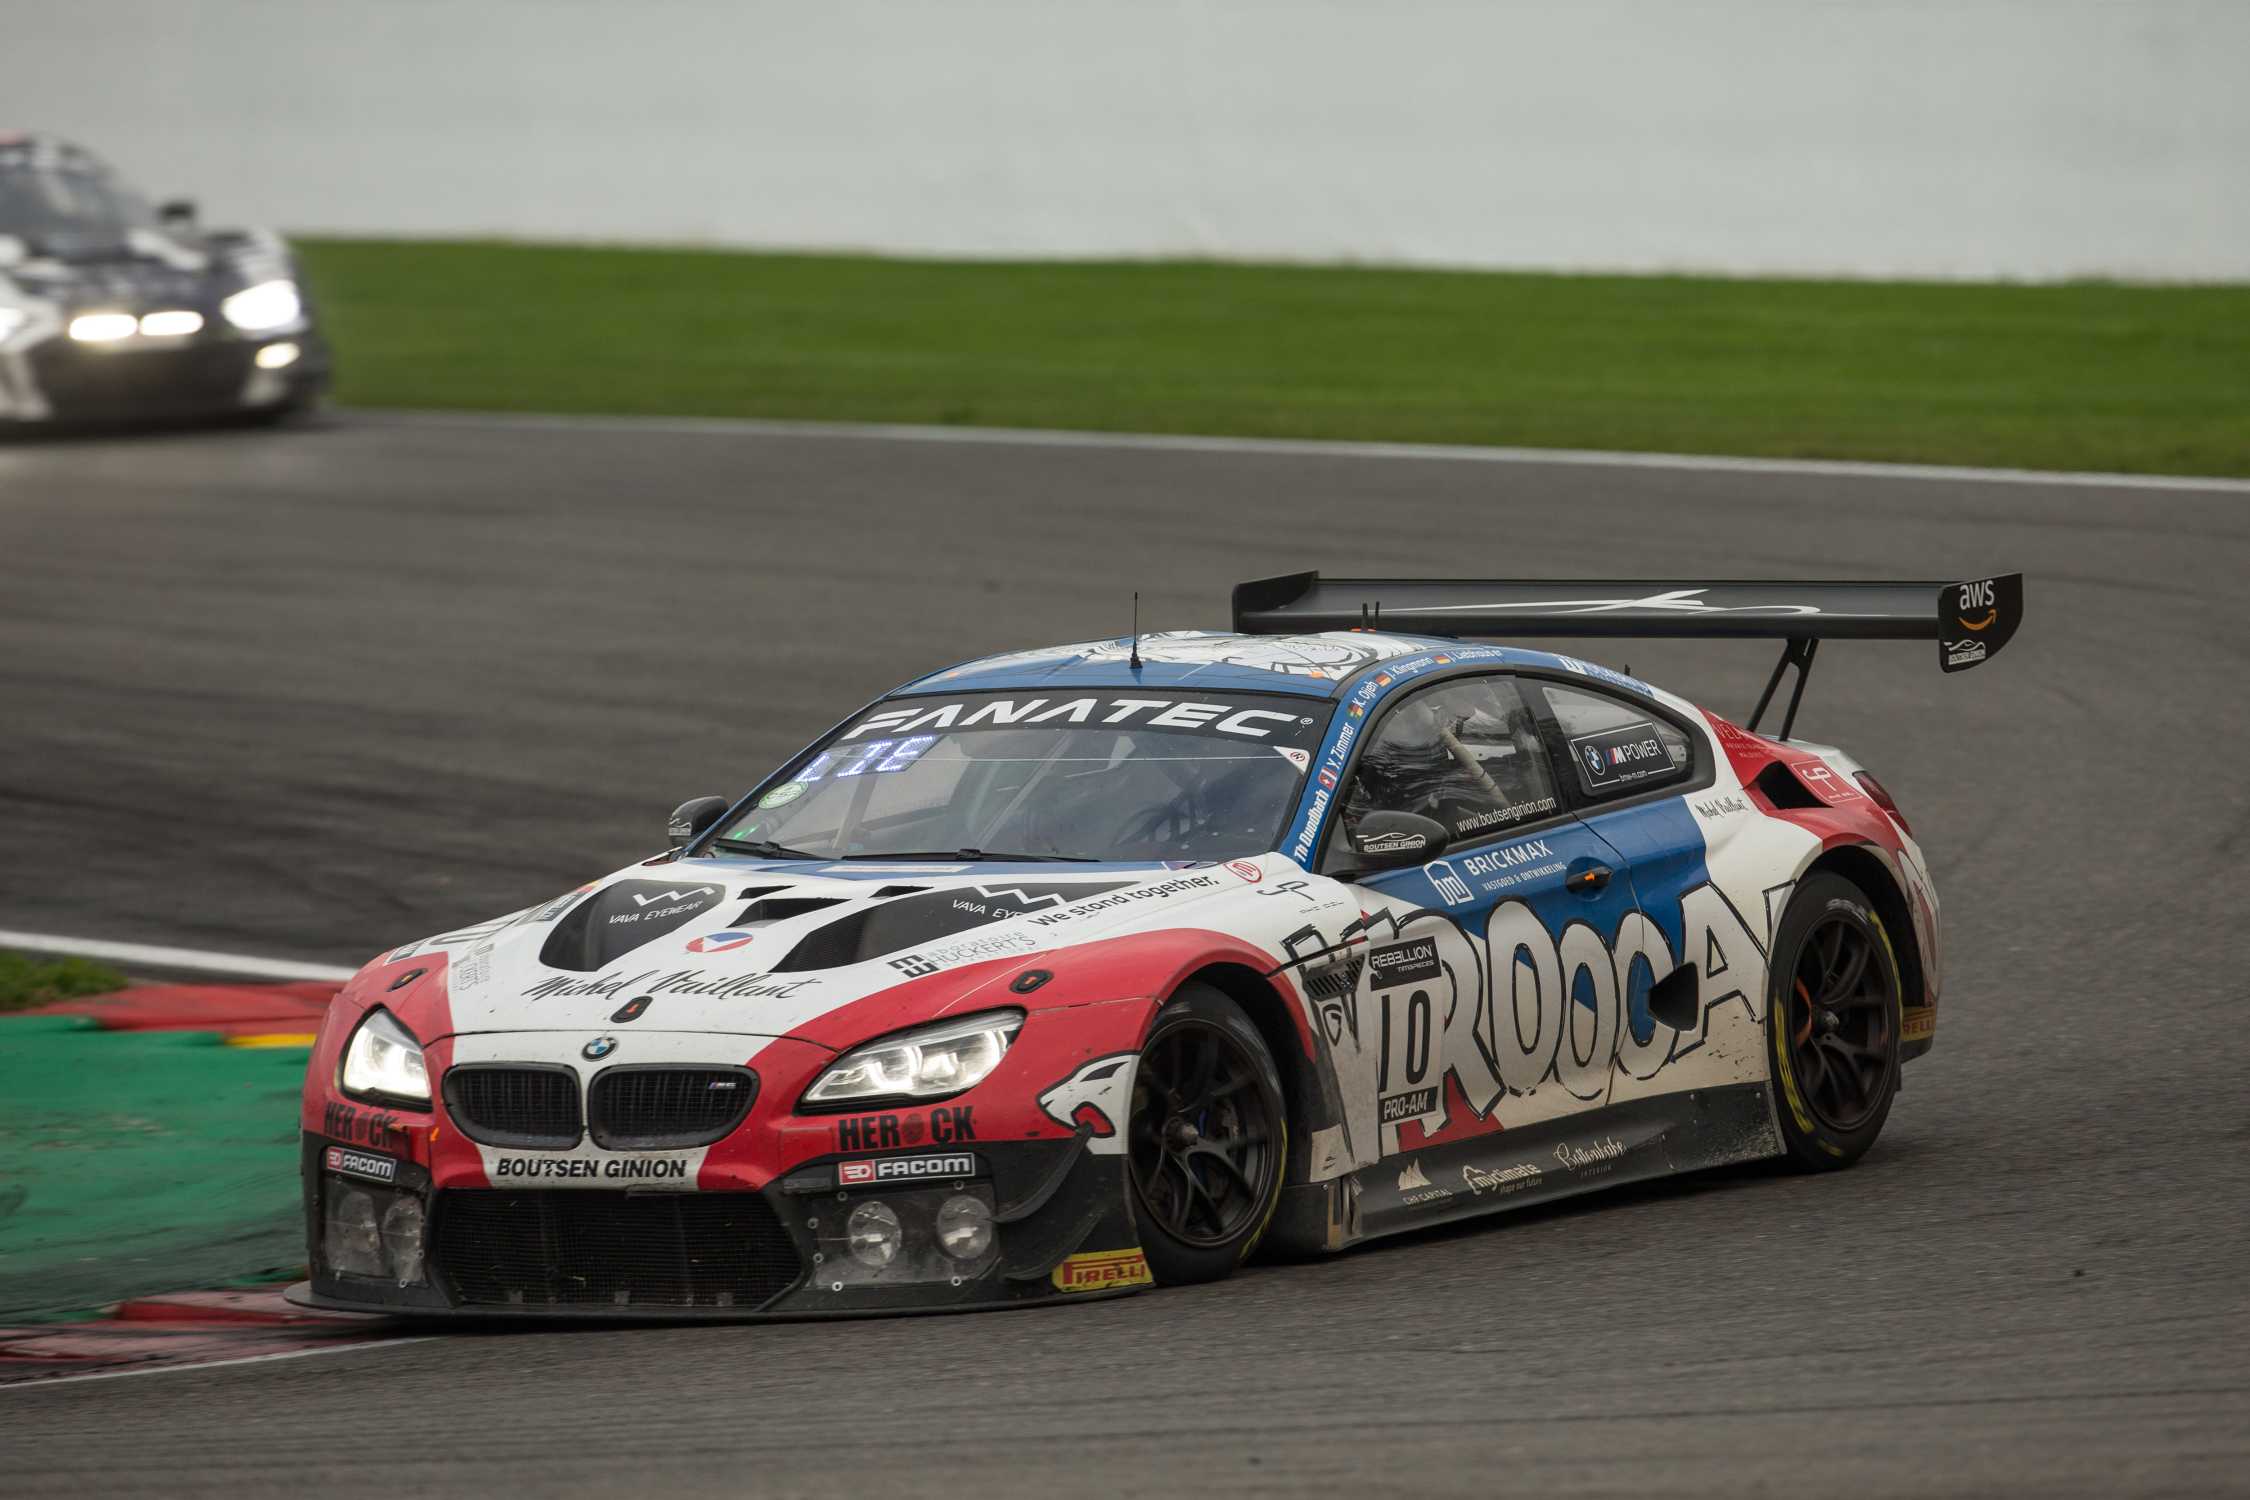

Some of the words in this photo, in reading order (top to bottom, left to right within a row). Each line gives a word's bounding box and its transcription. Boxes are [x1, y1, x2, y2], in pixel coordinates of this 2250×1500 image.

[1960, 580, 1994, 610] aws
[842, 698, 1299, 741] FANATEC
[1331, 721, 1356, 760] Zimmer
[1622, 739, 1663, 761] POWER
[1456, 795, 1556, 832] www.boutsenginion.com
[1363, 842, 1399, 852] BOUTSEN
[1463, 838, 1554, 876] BRICKMAX
[609, 913, 640, 924] VAVA
[644, 900, 703, 920] EYEWEAR
[952, 899, 986, 915] VAVA
[1028, 913, 1071, 927] We
[1069, 894, 1130, 916] stand
[1371, 945, 1433, 968] REBELLION
[520, 970, 660, 1001] Michel
[647, 970, 822, 1000] Vaillant
[1378, 989, 1431, 1092] 10
[1383, 1090, 1428, 1120] PRO-AM
[343, 1154, 392, 1177] FACOM
[497, 1158, 598, 1177] BOUTSEN
[604, 1159, 687, 1178] GINION
[878, 1158, 970, 1177] FACOM
[1473, 1163, 1542, 1191] myclimate
[1063, 1252, 1146, 1285] PIRELLI
